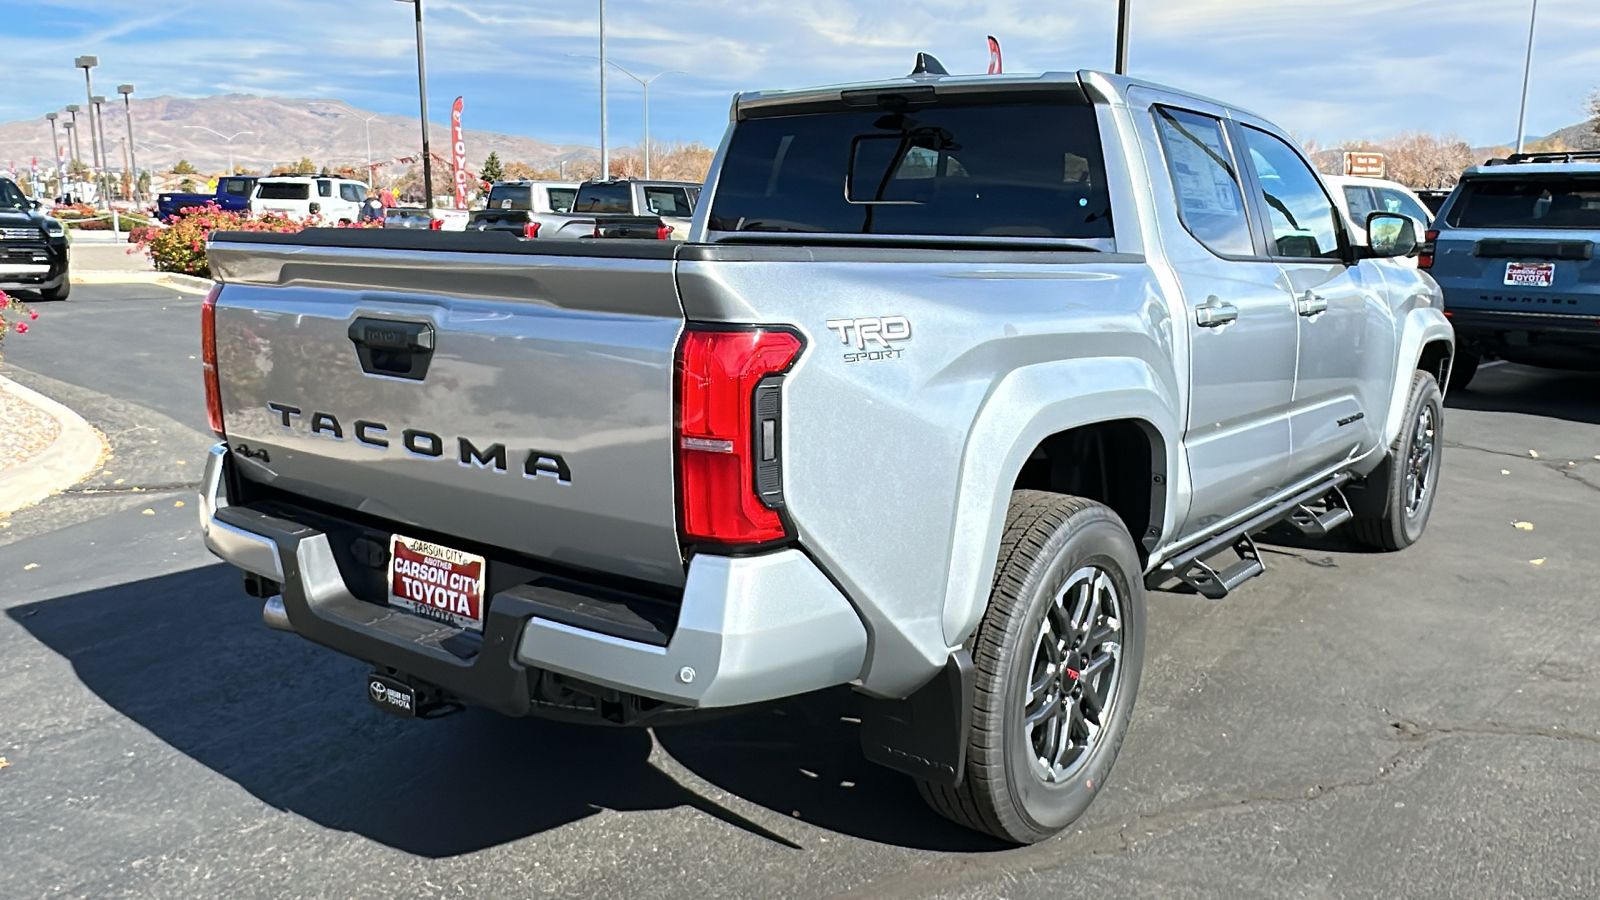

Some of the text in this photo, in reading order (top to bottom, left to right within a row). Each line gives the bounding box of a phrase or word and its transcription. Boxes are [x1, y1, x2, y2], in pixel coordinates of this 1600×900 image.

[1512, 274, 1546, 282] TOYOTA
[826, 315, 911, 350] TRD
[843, 348, 905, 363] SPORT
[267, 401, 572, 486] TACOMA
[413, 540, 464, 562] CARSON CITY
[423, 557, 453, 571] ANOTHER
[394, 557, 480, 595] CARSON CITY
[402, 576, 471, 616] TOYOTA
[387, 696, 411, 710] TOYOTA
